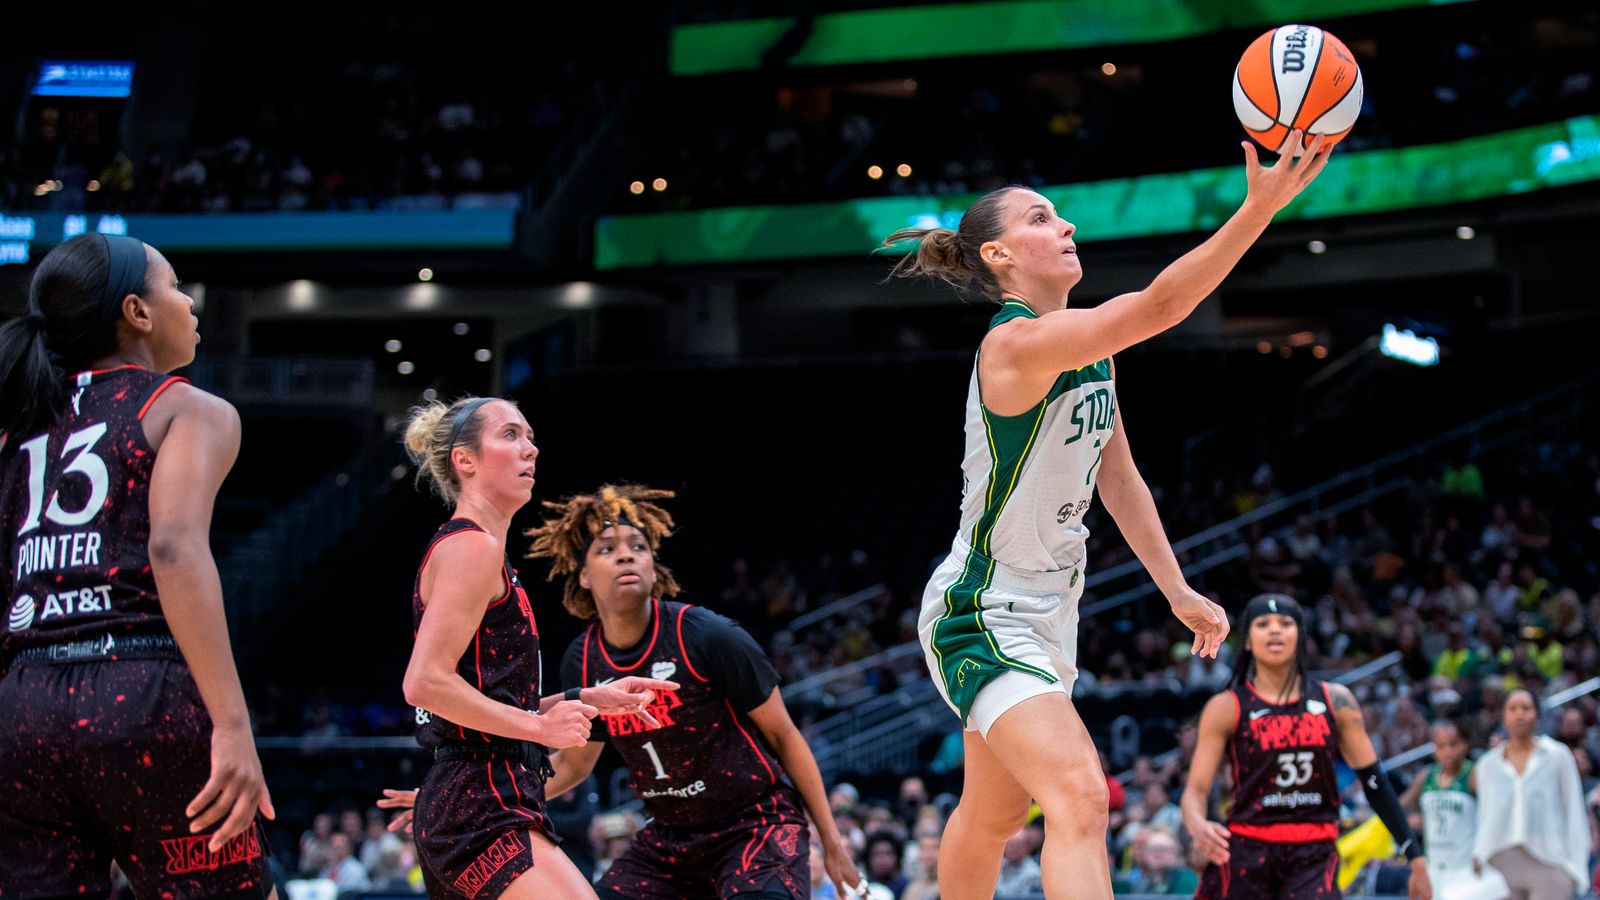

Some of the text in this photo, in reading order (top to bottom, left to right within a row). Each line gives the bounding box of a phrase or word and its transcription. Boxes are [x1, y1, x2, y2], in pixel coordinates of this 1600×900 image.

[1282, 25, 1308, 74] Wils
[1064, 388, 1116, 446] STOR
[17, 421, 109, 538] 13
[17, 531, 102, 581] POINTER
[40, 584, 113, 620] AT&T
[641, 741, 670, 780] 1
[1275, 751, 1315, 788] 33
[1262, 792, 1323, 809] salesforce
[453, 829, 527, 899] FEVER
